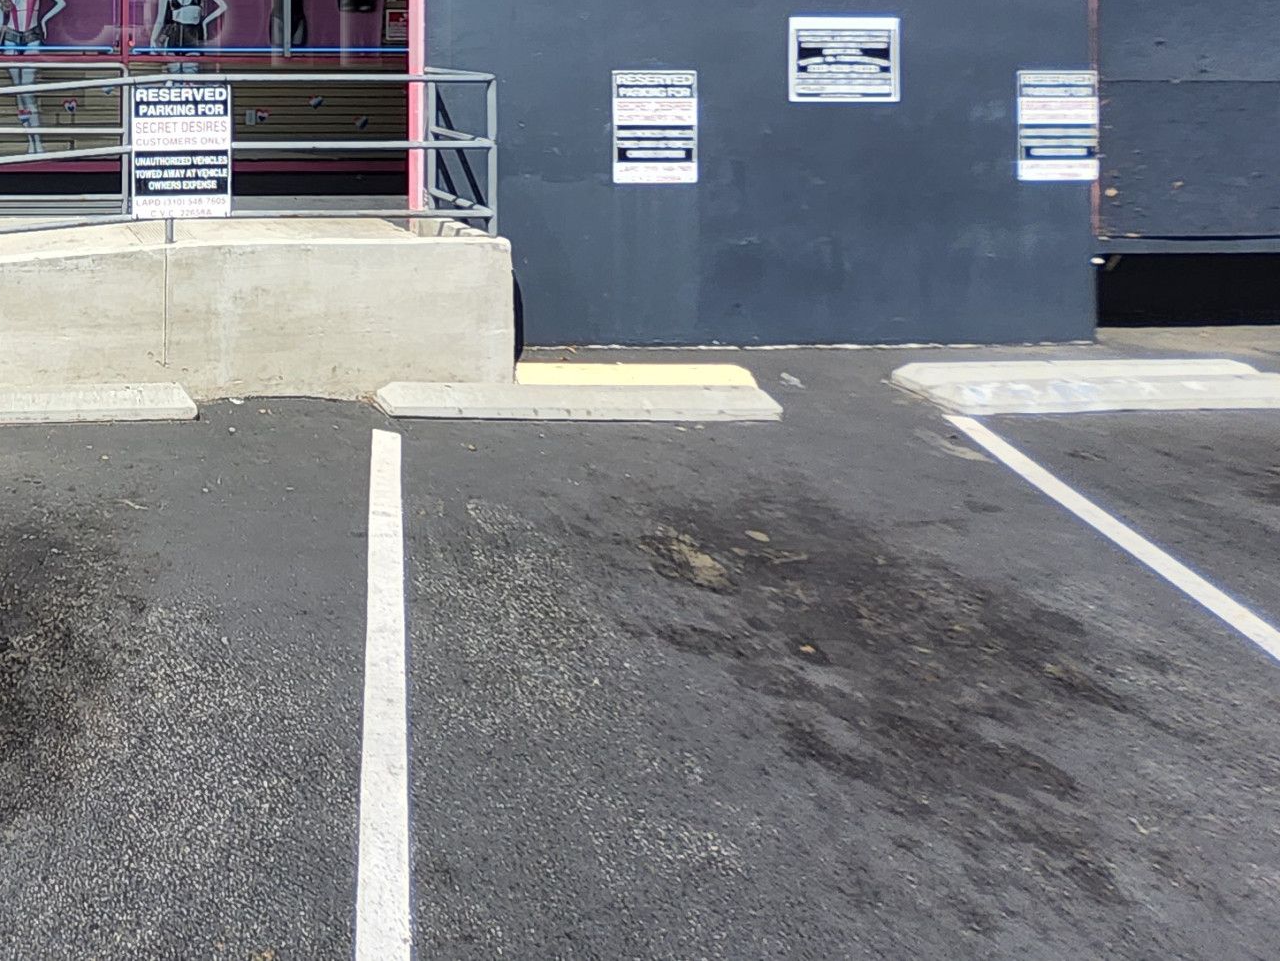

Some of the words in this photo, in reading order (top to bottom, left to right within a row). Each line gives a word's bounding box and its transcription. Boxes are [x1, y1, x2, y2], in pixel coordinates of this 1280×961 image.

[135, 88, 227, 101] RESERVED
[139, 105, 195, 116] PARKING
[197, 104, 224, 115] FOR
[135, 121, 178, 134] SECRET
[181, 120, 227, 133] DESIRES
[135, 137, 198, 147] CUSTOMERS
[200, 136, 226, 145] ONLY
[135, 156, 192, 166] UNAUTHORIZED
[192, 155, 228, 165] VEHICLES
[135, 169, 162, 179] TOWED
[162, 169, 186, 178] AWAY
[186, 168, 197, 177] AT
[197, 168, 228, 178] VEHICLE
[148, 180, 181, 190] OWNERS
[182, 180, 218, 189] EXPENSE
